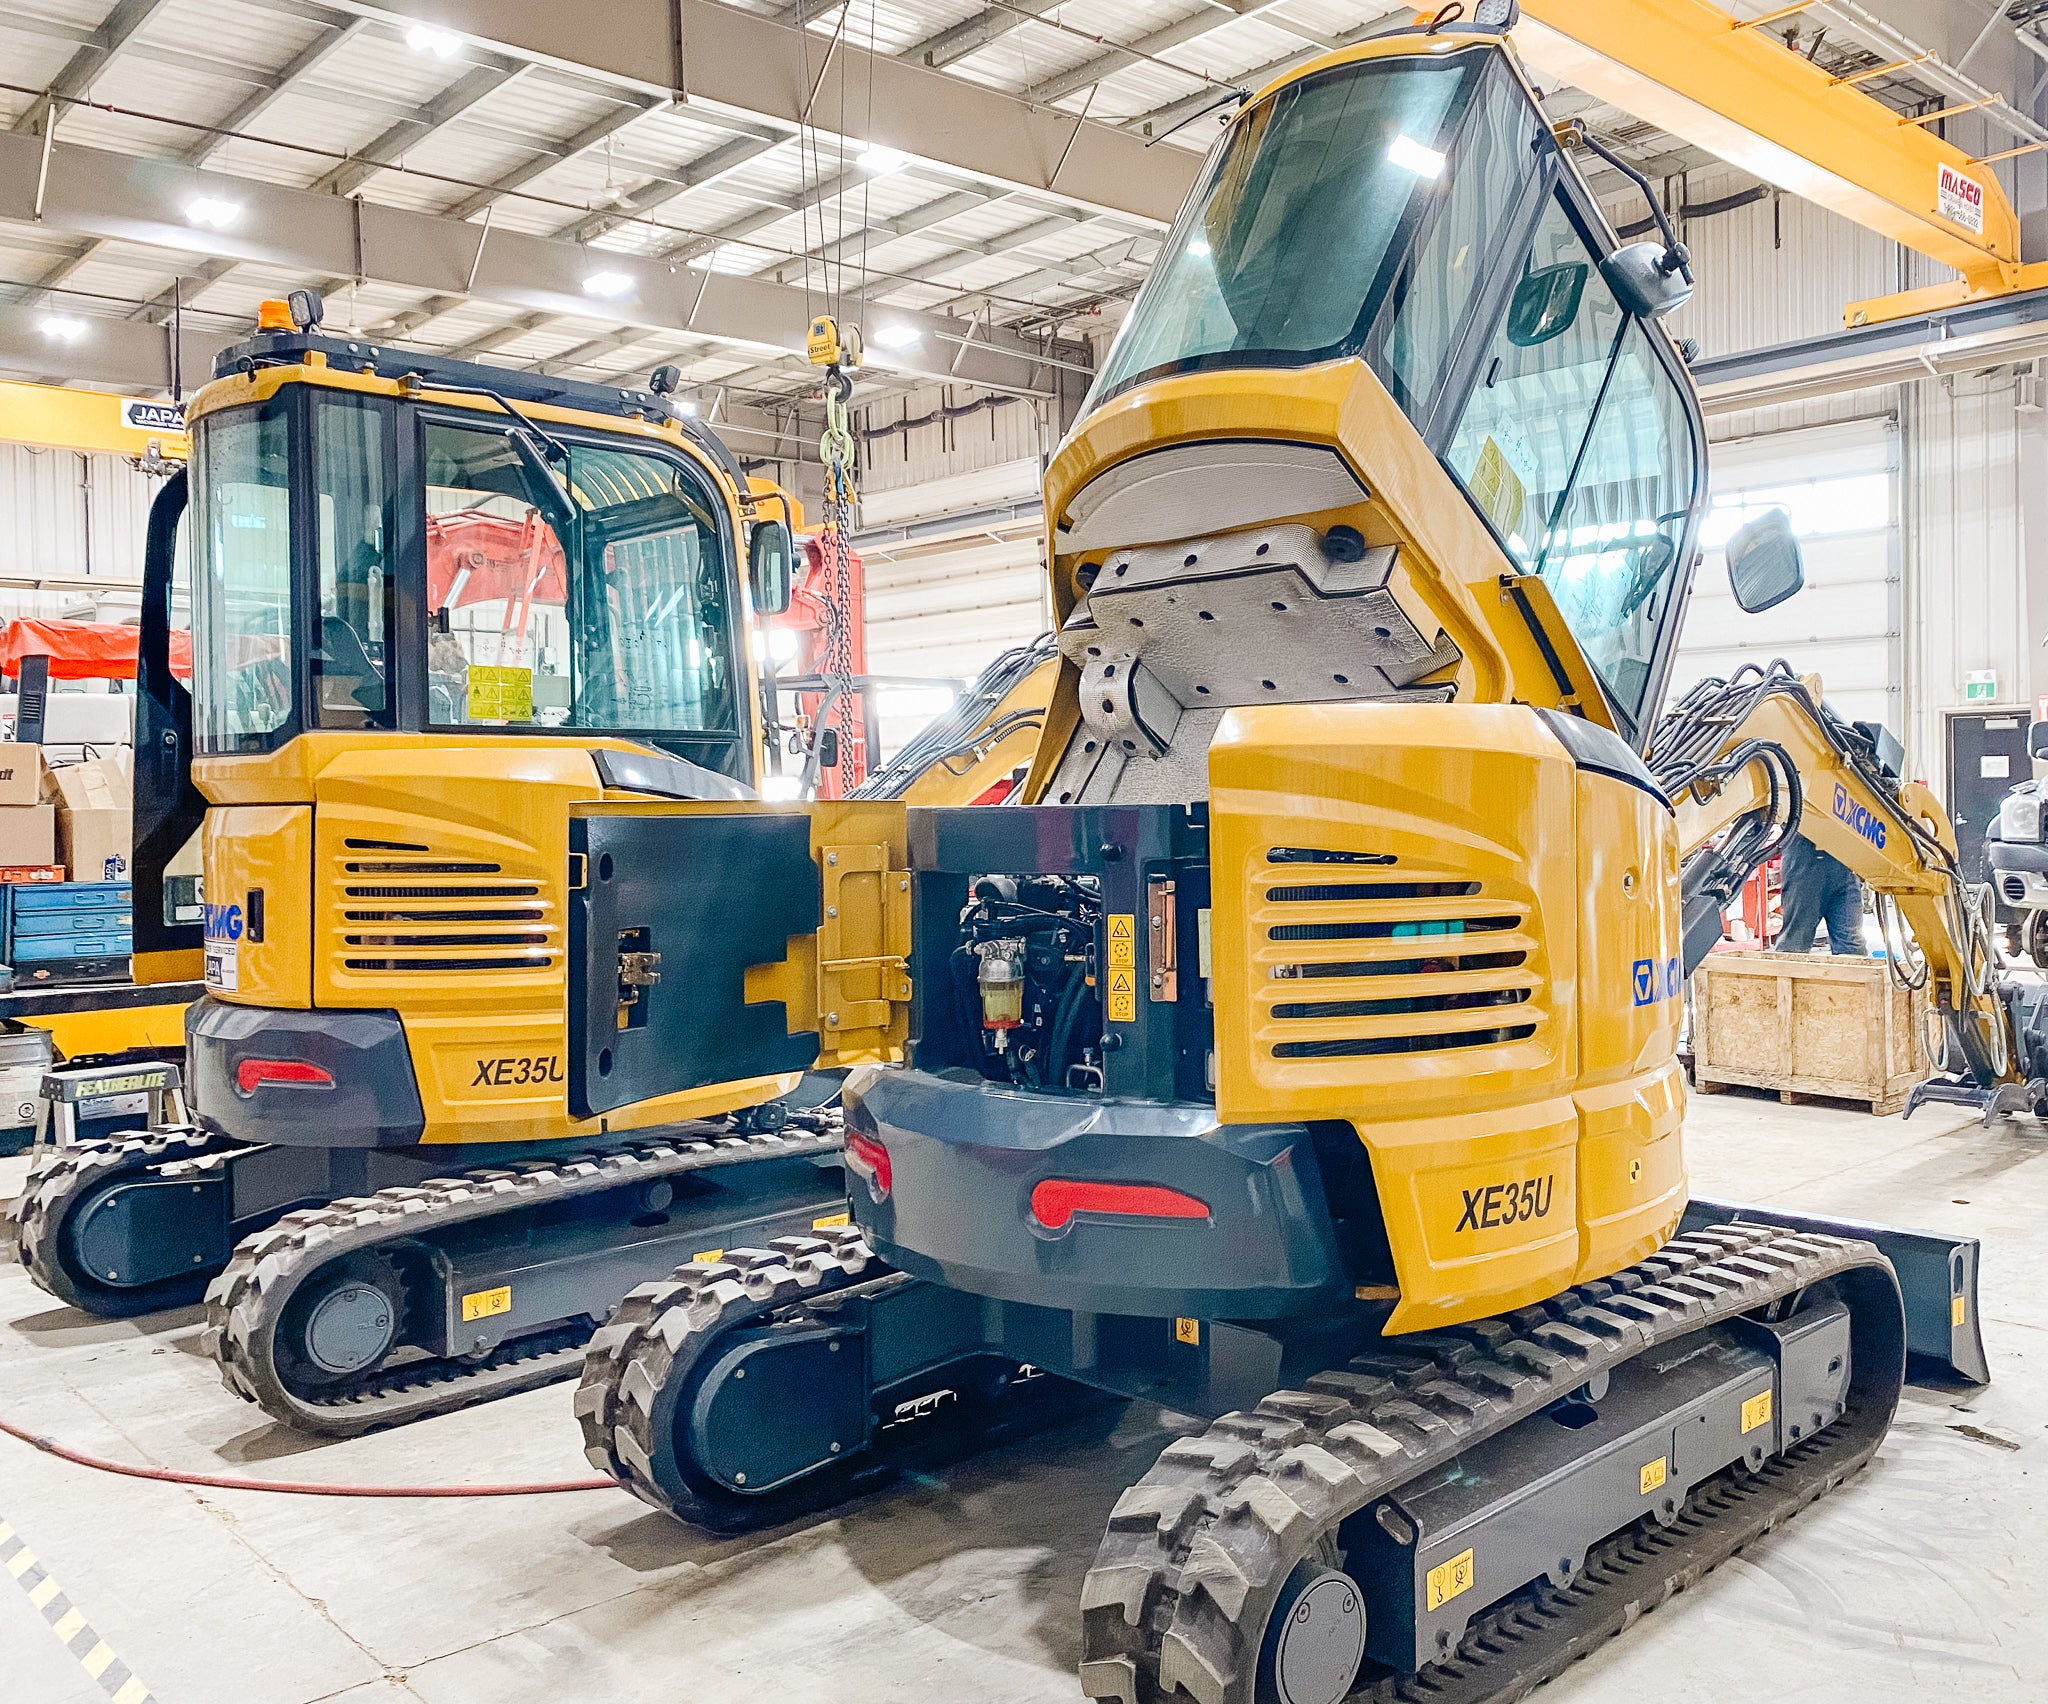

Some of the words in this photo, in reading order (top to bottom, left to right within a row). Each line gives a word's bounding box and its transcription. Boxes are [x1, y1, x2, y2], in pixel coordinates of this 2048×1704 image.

[810, 344, 831, 354] Street
[134, 406, 185, 426] JAPA
[0, 768, 14, 781] dt
[1845, 796, 1887, 849] XCMG
[204, 903, 242, 940] CMG
[75, 1071, 167, 1097] FEATHERLITE
[471, 1055, 564, 1087] XE35U
[1455, 1174, 1554, 1233] XE35U
